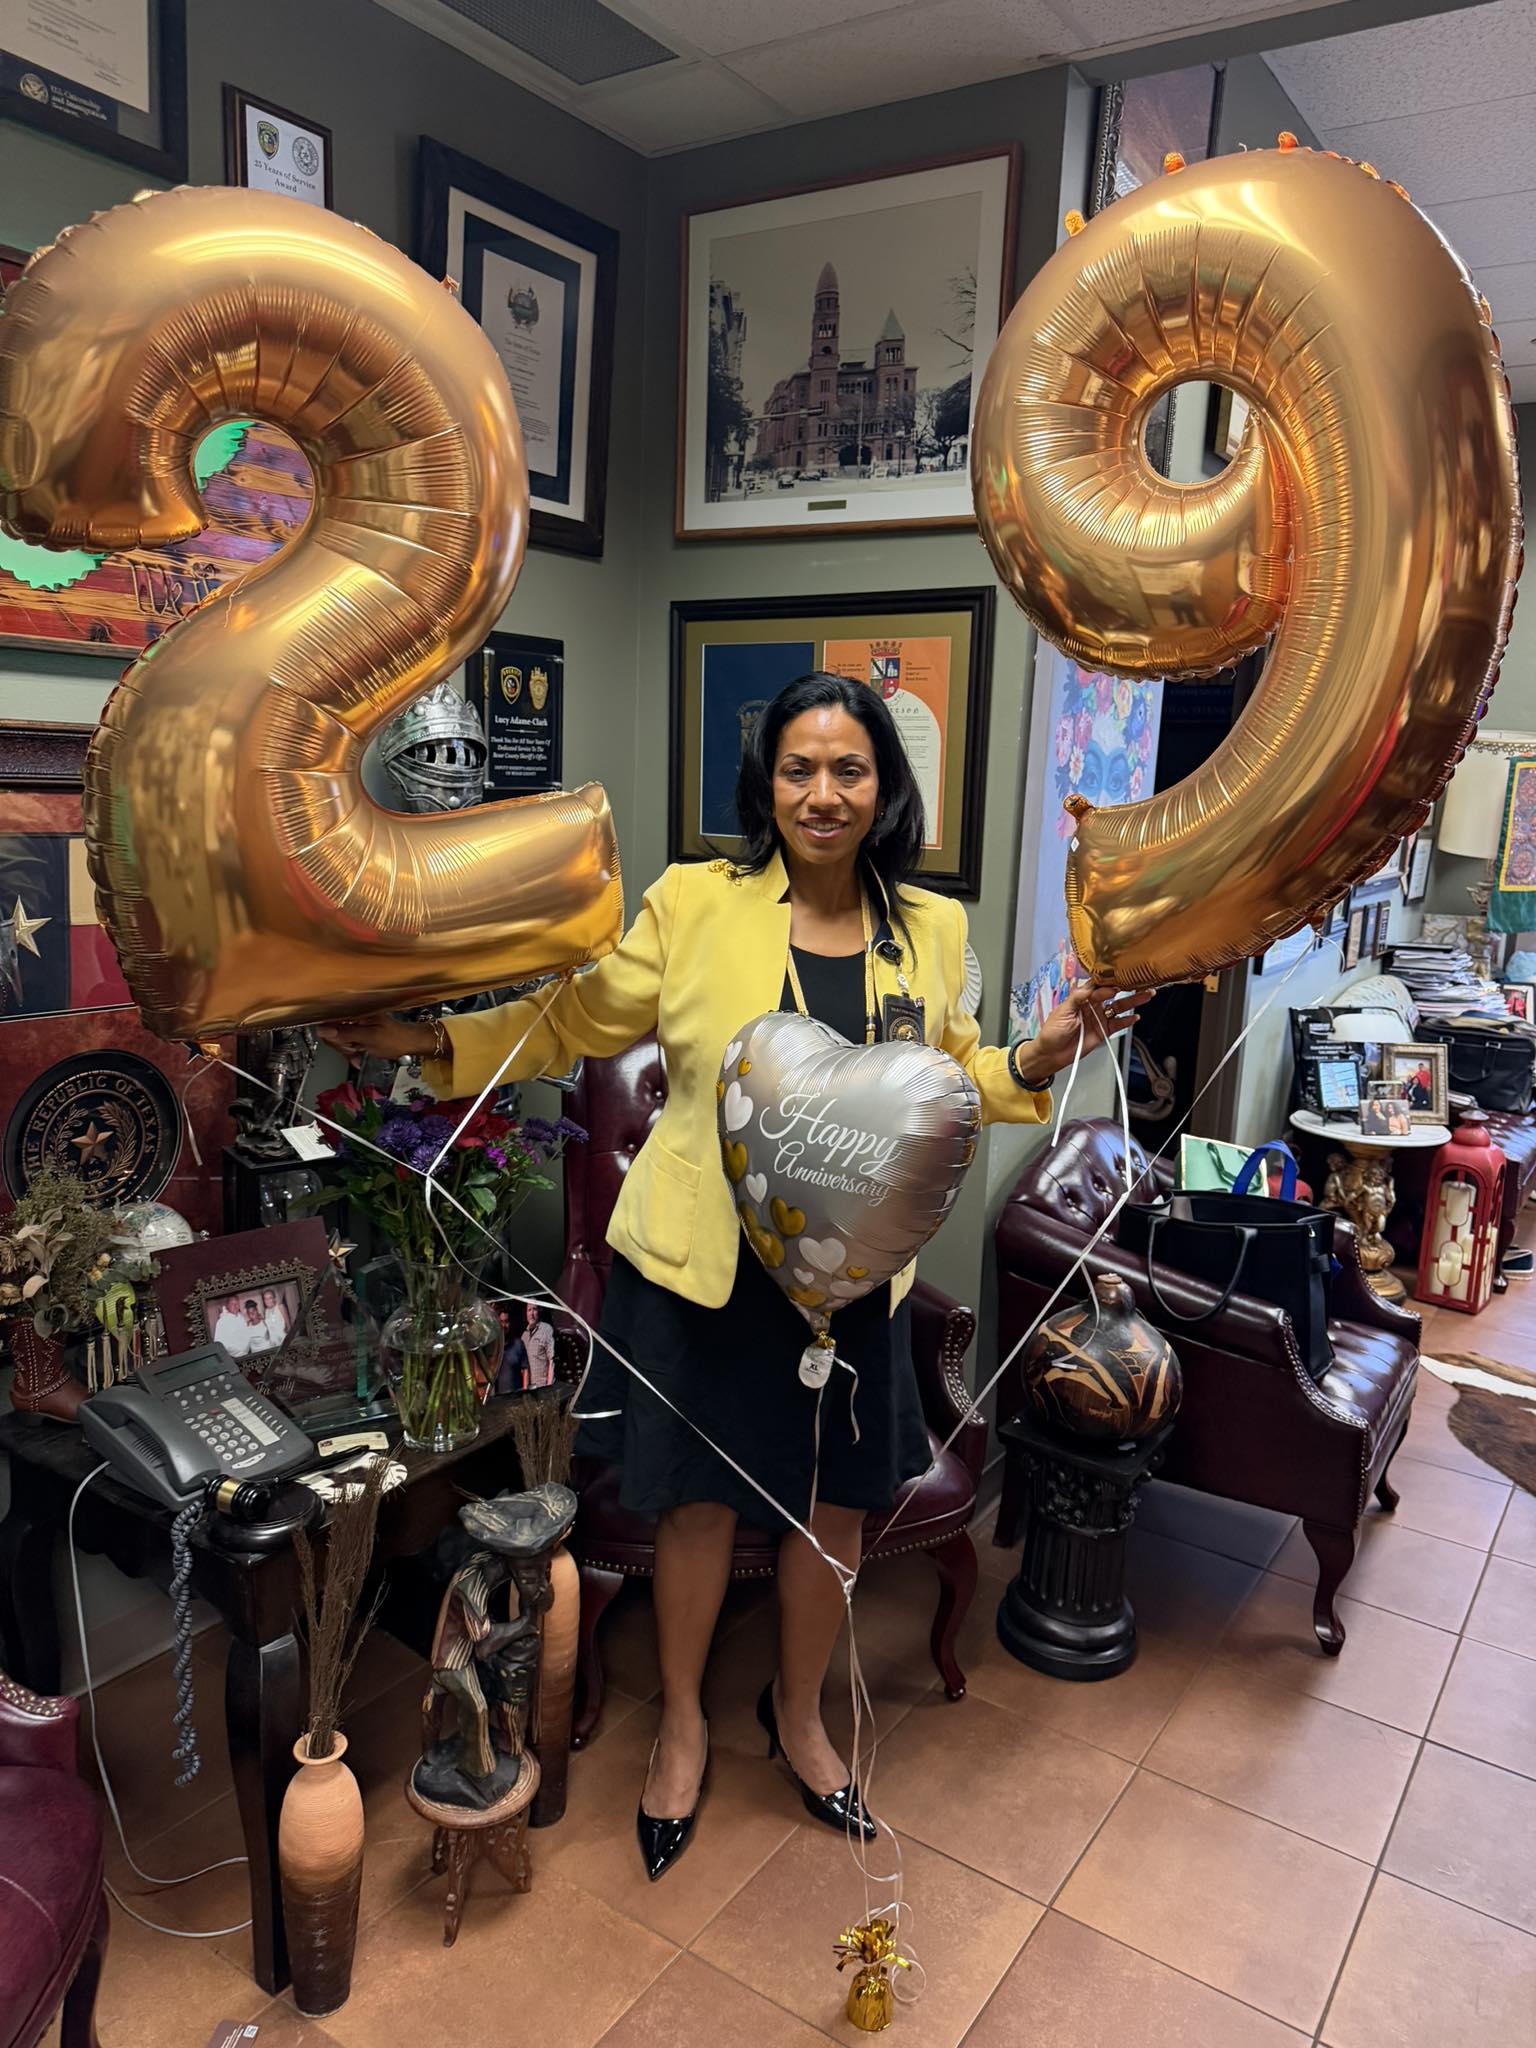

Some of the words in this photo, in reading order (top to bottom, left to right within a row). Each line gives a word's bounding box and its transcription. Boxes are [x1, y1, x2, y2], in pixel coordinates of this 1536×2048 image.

[263, 162, 283, 176] Years
[283, 172, 291, 181] of
[291, 175, 316, 190] Service
[274, 178, 297, 193] Award
[494, 714, 510, 726] Lucy
[31, 1075, 108, 1132] REPUBLIC
[115, 1078, 137, 1095] OF
[136, 1094, 157, 1154] TEXAS
[759, 1091, 904, 1175] Happy
[774, 1139, 891, 1208] Anniversary
[809, 1362, 818, 1371] XL
